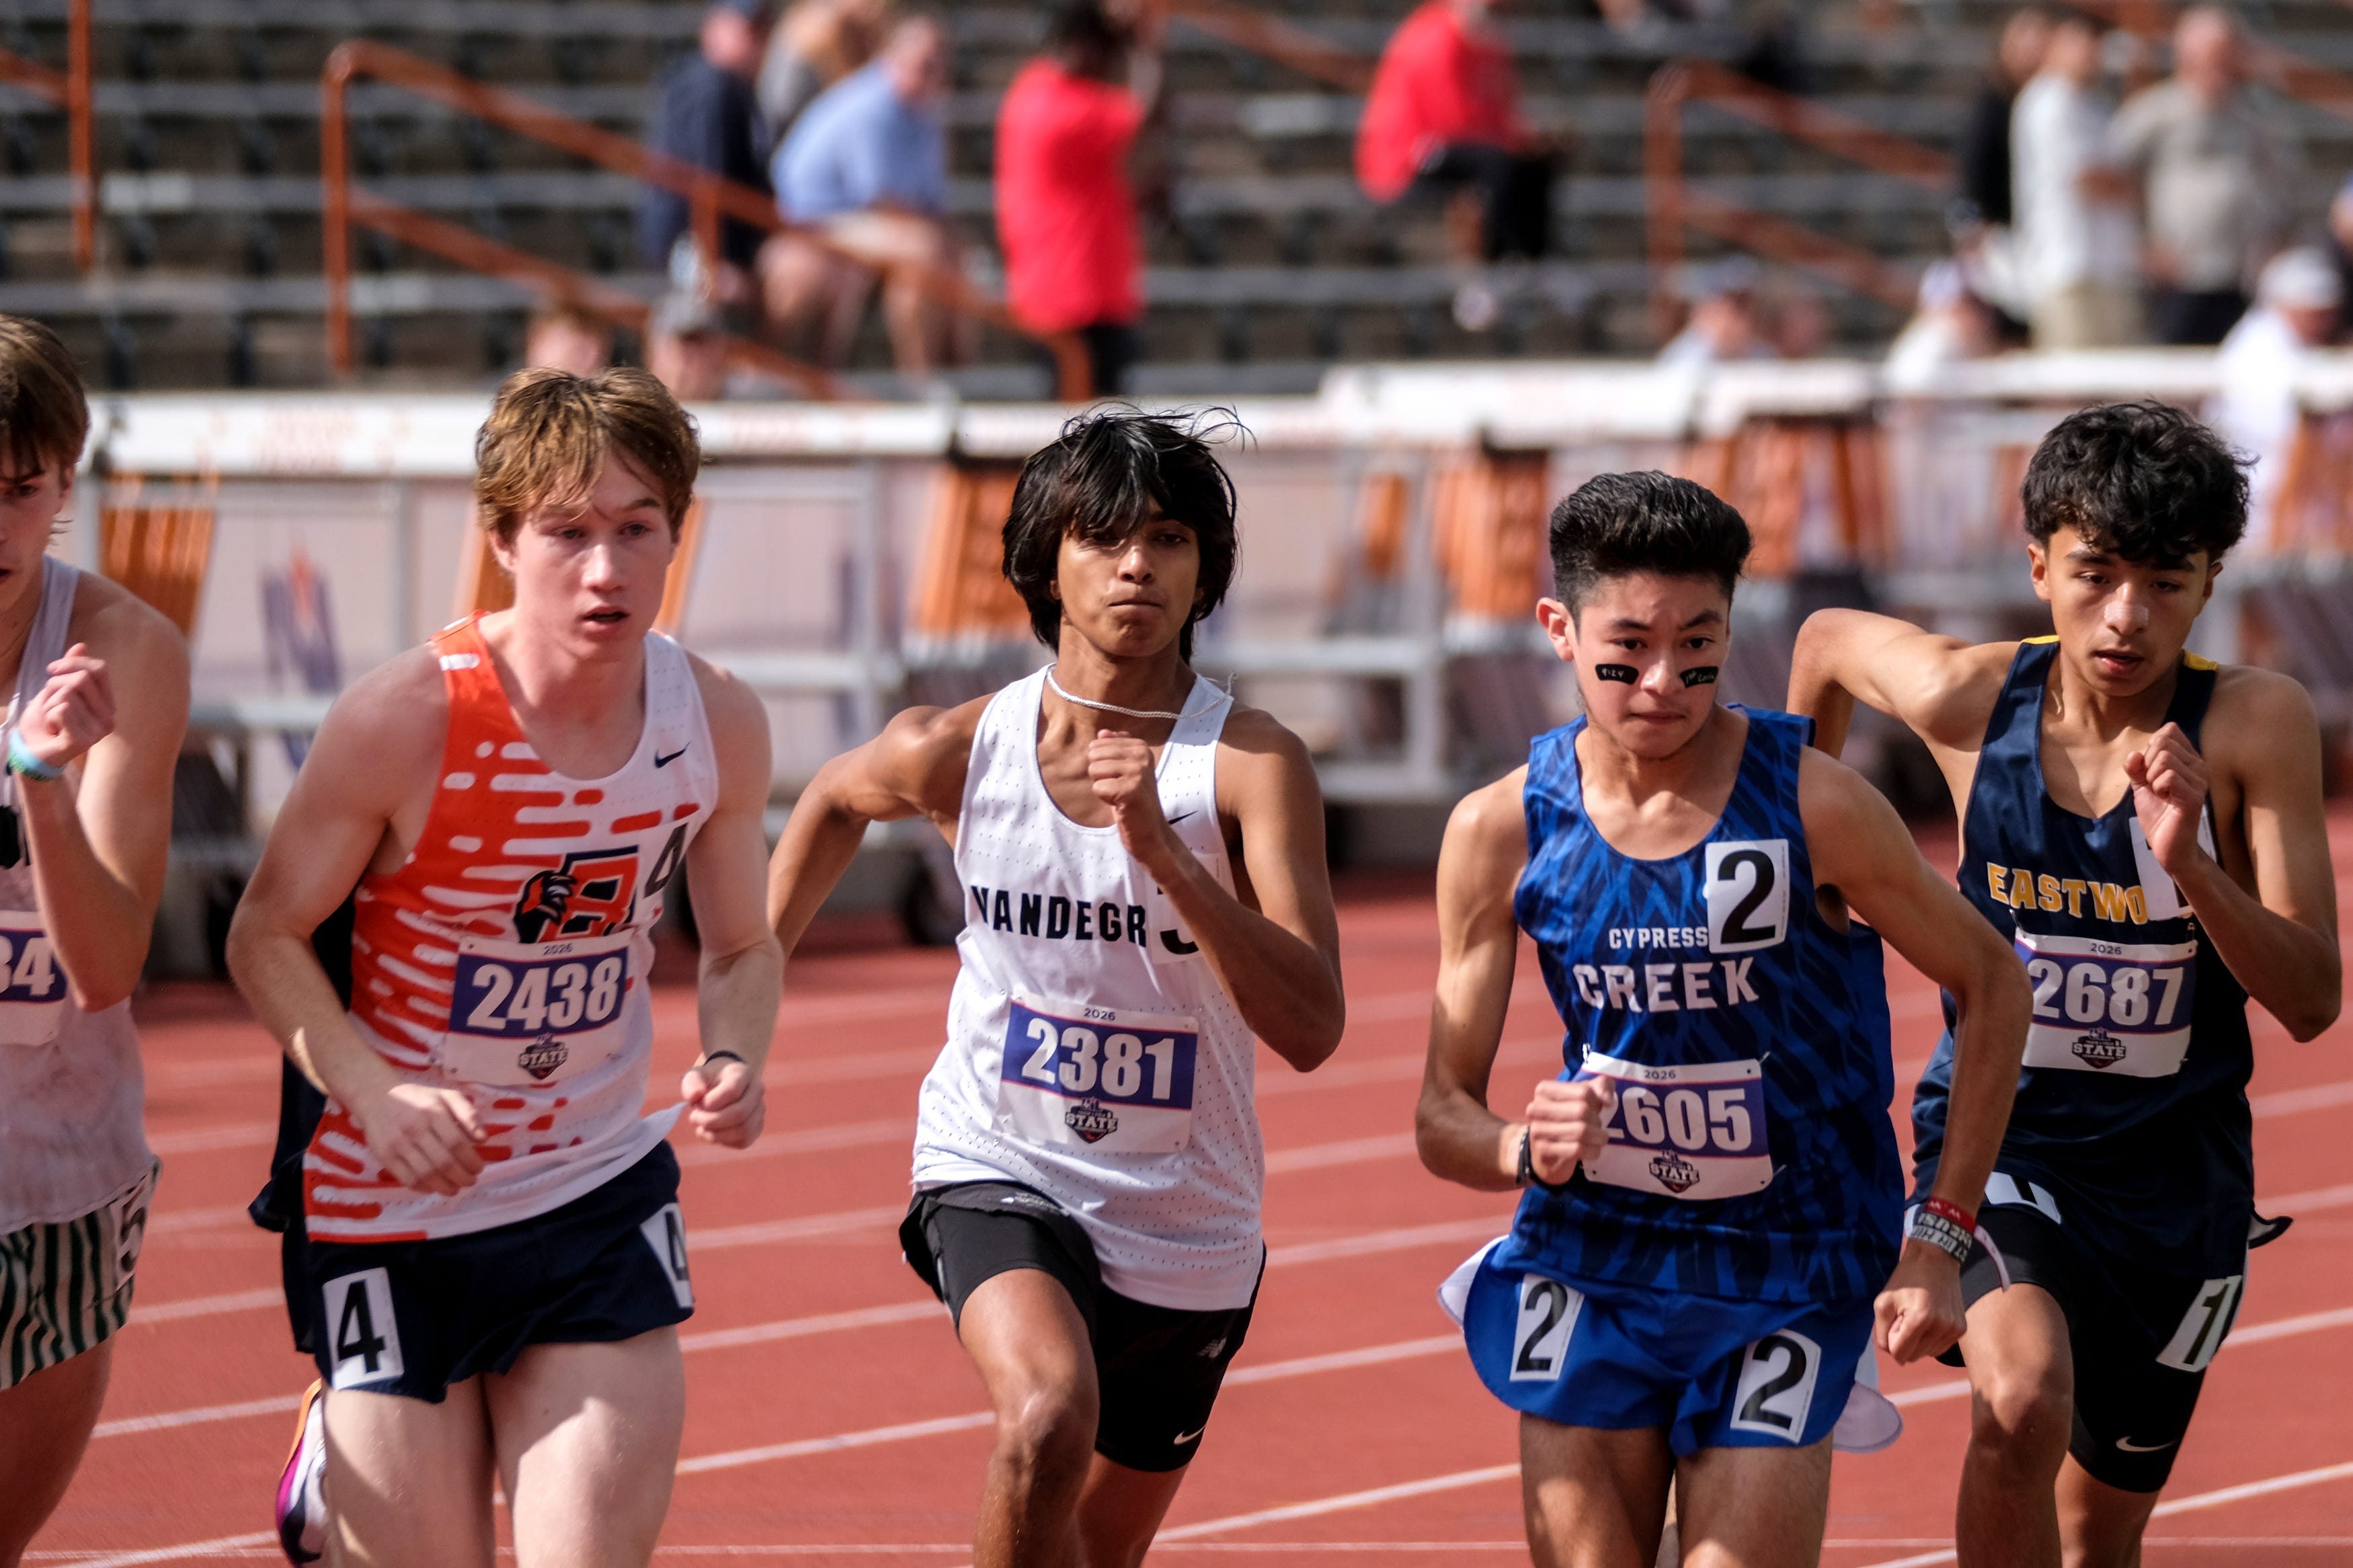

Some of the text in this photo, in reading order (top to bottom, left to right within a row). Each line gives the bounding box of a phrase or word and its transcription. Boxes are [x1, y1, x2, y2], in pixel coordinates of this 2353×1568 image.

[971, 885, 1146, 947] VANDEGR
[1718, 849, 1776, 944] 2
[1987, 862, 2147, 925] EASTWO
[543, 944, 573, 955] 2026
[1609, 927, 1708, 948] CYPRESS
[2091, 943, 2122, 955] 2026
[467, 958, 620, 1030] 2438
[1572, 956, 1758, 1012] CREEK
[2026, 958, 2184, 1026] 2687
[1084, 1007, 1115, 1021] 2026
[519, 1050, 568, 1065] STATE
[1022, 1018, 1174, 1100] 2381
[1644, 1069, 1677, 1079] 2026
[2073, 1043, 2125, 1057] STATE
[1066, 1113, 1117, 1129] STATE
[1650, 1163, 1699, 1184] STATE
[337, 1280, 385, 1373] 4
[1516, 1280, 1568, 1372] 2
[2182, 1284, 2229, 1365] 1
[1739, 1335, 1806, 1430] 2
